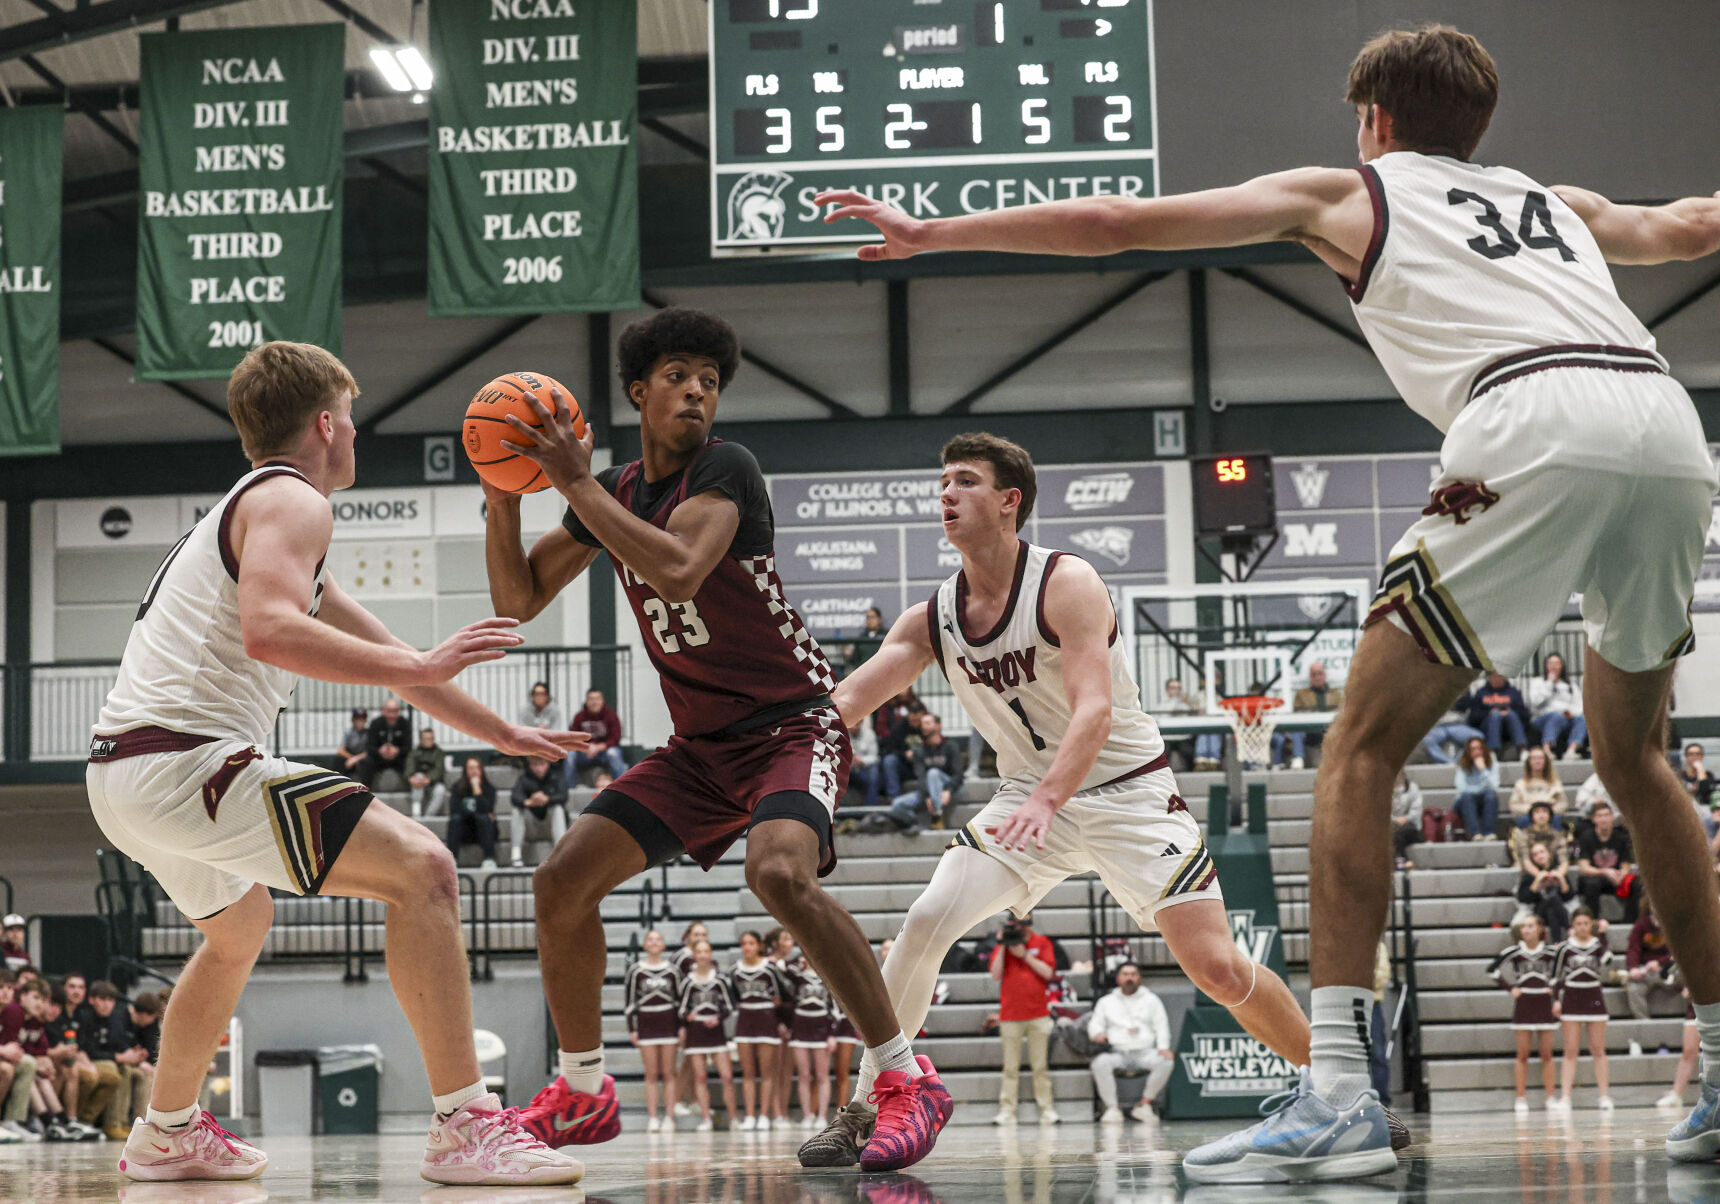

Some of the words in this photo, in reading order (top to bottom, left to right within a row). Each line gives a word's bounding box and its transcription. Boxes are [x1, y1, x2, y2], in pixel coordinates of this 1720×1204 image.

[492, 0, 575, 21] NCAA
[483, 37, 540, 65] DIV.
[546, 35, 580, 61] III
[903, 25, 958, 50] period
[202, 58, 285, 85] NCAA
[745, 73, 780, 96] FLS
[899, 66, 965, 90] PLAYER
[1084, 61, 1119, 83] FLS
[486, 78, 578, 108] MEN'S
[193, 101, 250, 129] DIV.
[255, 100, 288, 127] III
[765, 107, 792, 154] 3
[815, 105, 845, 152] 5
[1021, 98, 1051, 145] 5
[1103, 95, 1132, 142] 2
[438, 121, 630, 153] BASKETBALL
[195, 144, 285, 172] MEN'S
[481, 168, 577, 196] THIRD
[146, 186, 333, 217] BASKETBALL
[483, 211, 582, 241] PLACE
[1447, 187, 1579, 263] 34
[188, 232, 283, 260] THIRD
[503, 256, 563, 284] 2006
[190, 276, 285, 305] PLACE
[208, 320, 264, 348] 2001
[1158, 418, 1181, 447] H
[429, 442, 450, 474] G
[1216, 460, 1246, 482] 55
[808, 482, 884, 501] COLLEGE
[796, 502, 821, 519] OF
[824, 499, 893, 518] ILLINOIS
[895, 498, 913, 516] &
[795, 540, 877, 557] AUGUSTANA
[1284, 523, 1338, 556] M
[809, 556, 864, 571] VIKINGS
[643, 597, 711, 654] 23
[1008, 697, 1047, 751] 1
